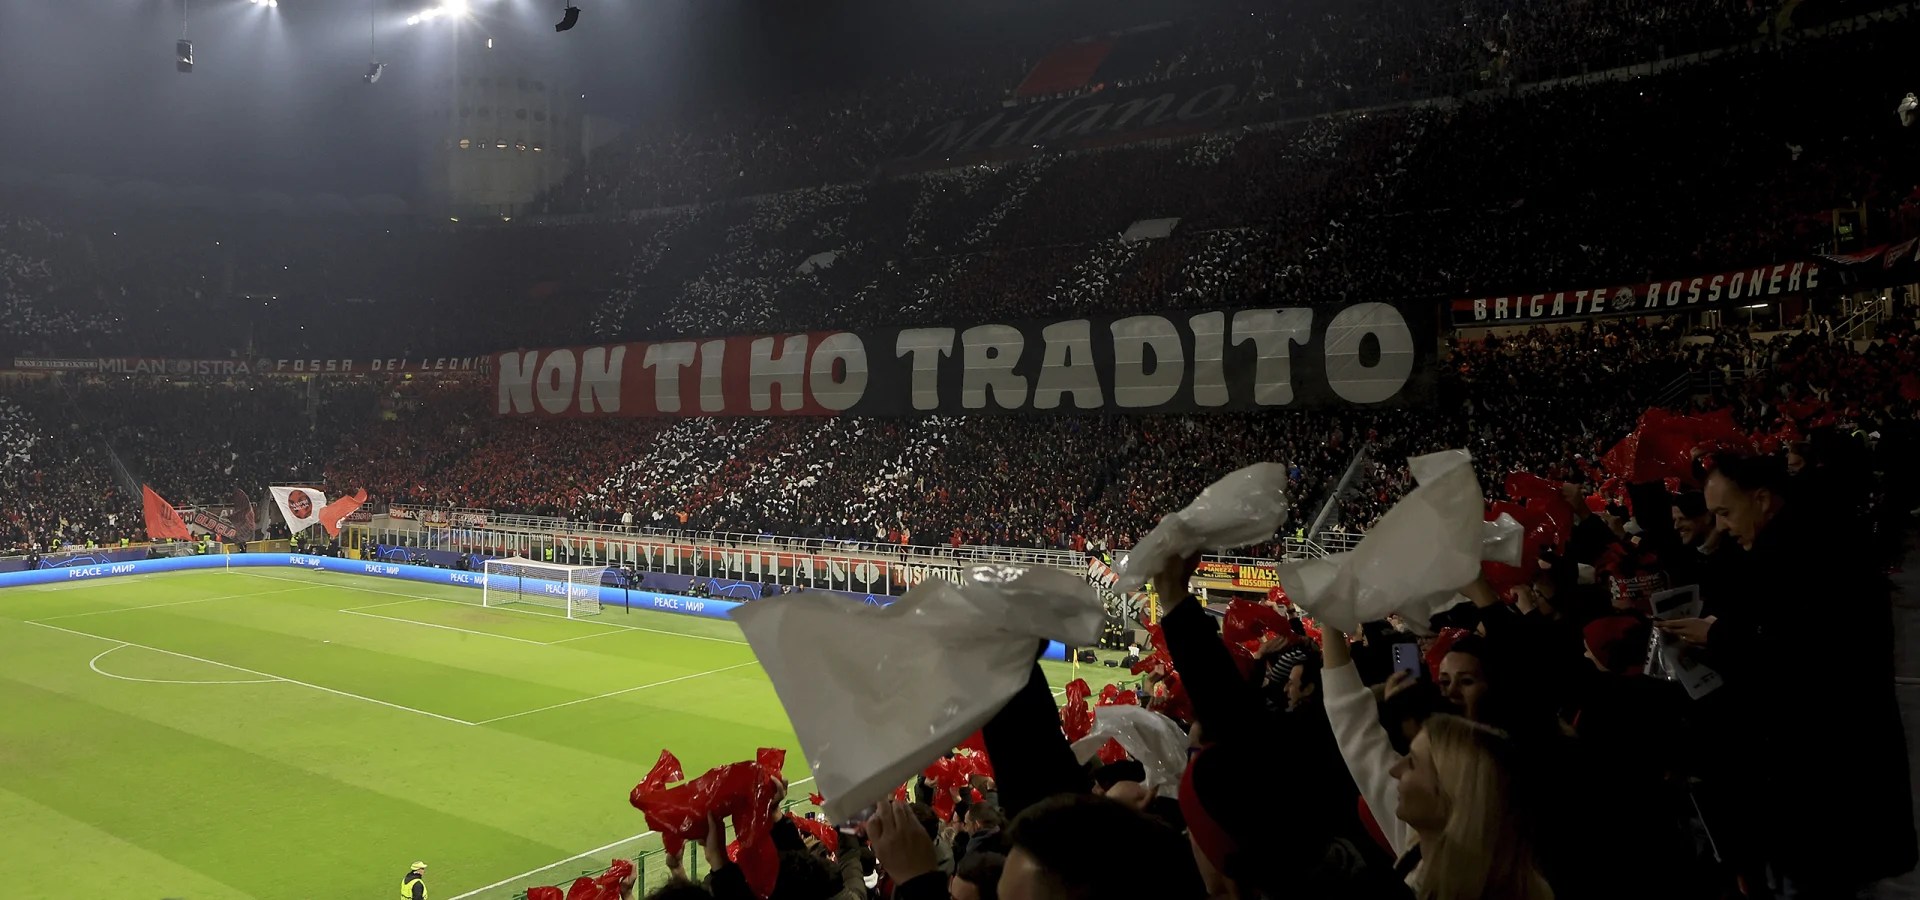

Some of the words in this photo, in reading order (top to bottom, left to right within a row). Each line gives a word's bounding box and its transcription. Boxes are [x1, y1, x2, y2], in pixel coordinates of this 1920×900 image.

[898, 83, 1238, 161] Milano
[1473, 288, 1607, 321] BRIGATE
[277, 359, 354, 371] FOSSA
[371, 358, 407, 371] DEI
[421, 357, 479, 370] LEONI
[497, 345, 627, 415] NON
[641, 339, 727, 413] TI
[749, 332, 869, 412] HO
[896, 301, 1416, 411] TRADITO
[98, 358, 166, 373] MILAN
[192, 360, 251, 375] ISTRA
[289, 556, 304, 565] PEACE
[307, 557, 320, 567] МИР
[719, 551, 881, 585] MILANO
[69, 568, 102, 578] PEACE
[111, 564, 136, 574] МИР
[365, 563, 382, 574] PEACE
[385, 566, 399, 576] МИР
[450, 573, 469, 583] PEACE
[545, 583, 564, 594] PEACE
[571, 586, 588, 598] МИР
[654, 596, 679, 609] PEACE
[685, 598, 704, 612] МИР
